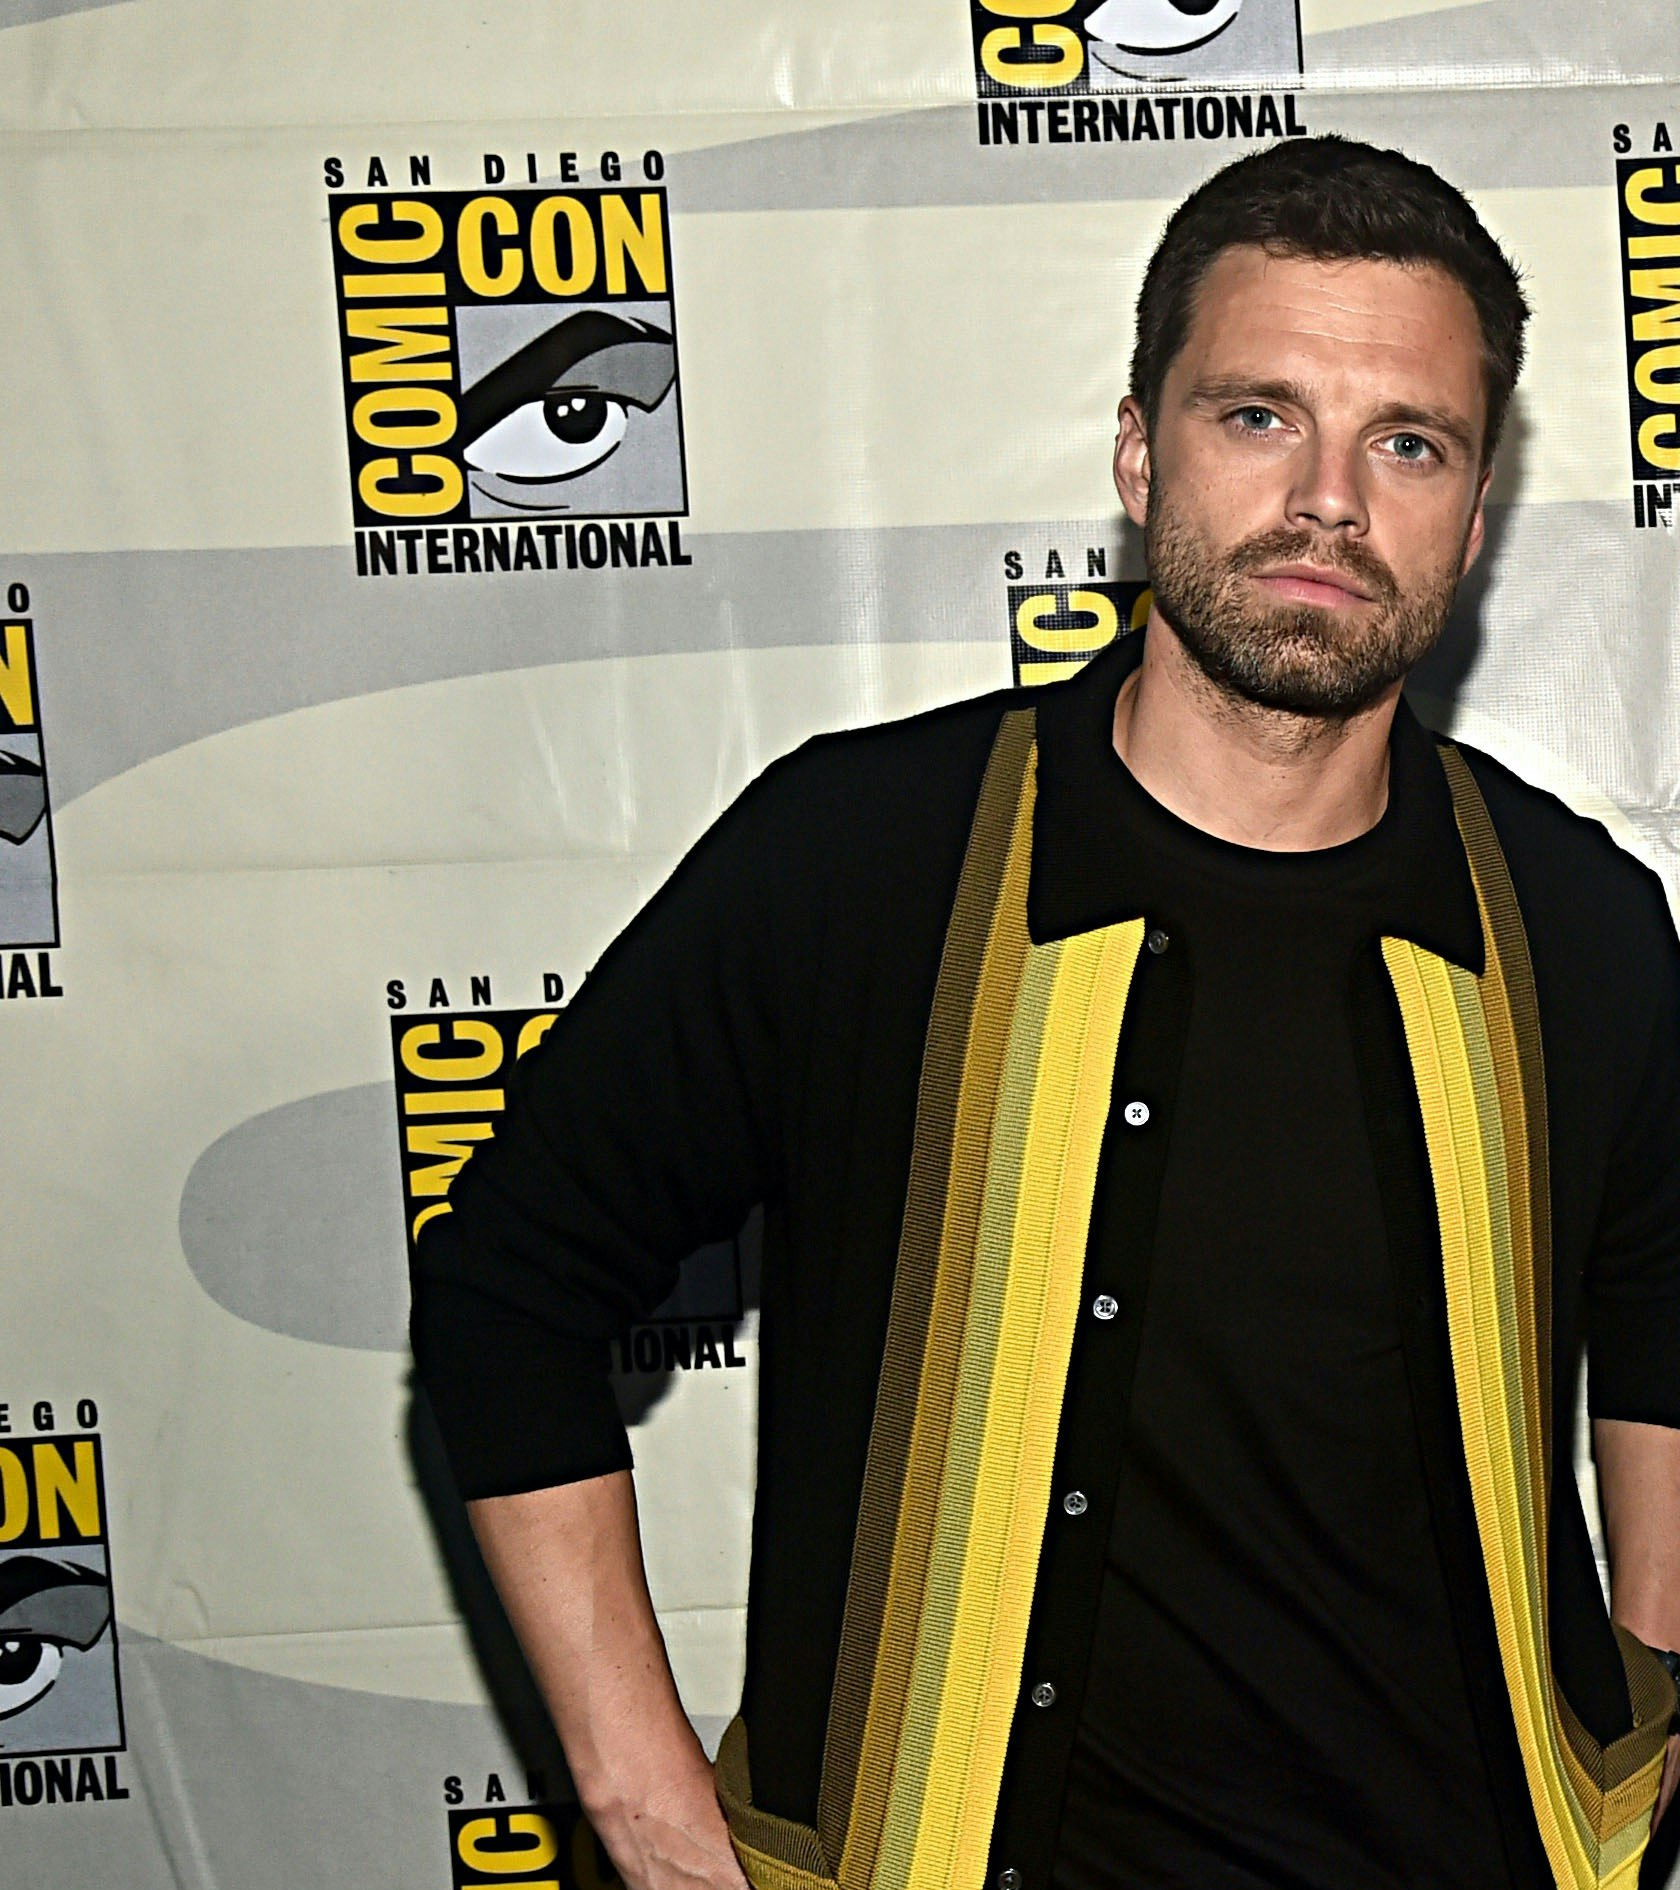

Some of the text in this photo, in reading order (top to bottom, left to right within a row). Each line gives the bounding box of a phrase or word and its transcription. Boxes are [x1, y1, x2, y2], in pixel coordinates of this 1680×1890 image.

[977, 94, 1307, 146] INTERNATIONAL
[324, 150, 664, 188] SAN DIEGO
[456, 193, 668, 298] CON
[337, 200, 464, 517] COMIC
[354, 521, 693, 577] INTERNATIONAL
[1004, 547, 1106, 580] SAN
[386, 975, 491, 1010] SAN
[399, 1019, 506, 1244] MIC
[0, 1398, 99, 1433] EGO
